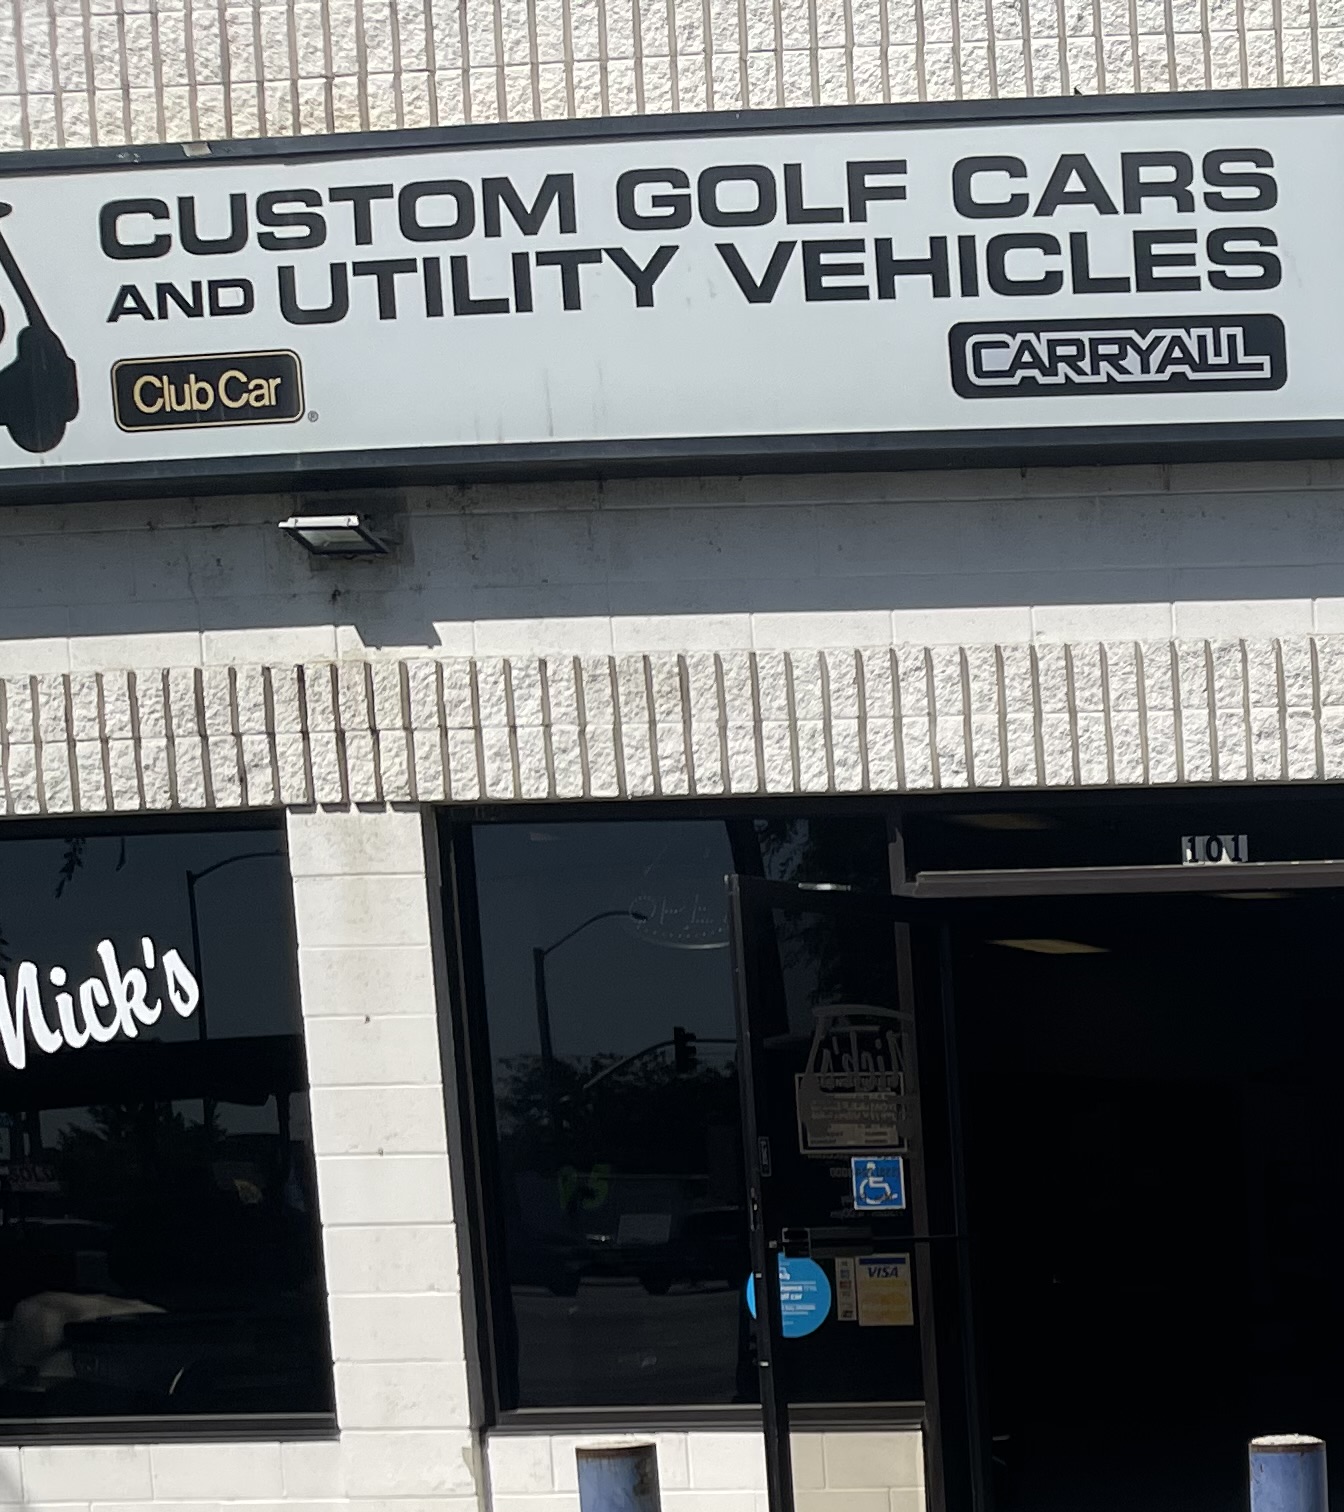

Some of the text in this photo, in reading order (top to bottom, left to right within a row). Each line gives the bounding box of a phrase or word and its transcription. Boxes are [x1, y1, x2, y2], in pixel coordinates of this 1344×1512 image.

[99, 148, 1278, 261] CUSTOM GOLF CARS
[106, 226, 1282, 326] AND UTILITY VEHICLES
[964, 326, 1272, 386] CARRYALL
[133, 368, 282, 416] Club Car
[1187, 834, 1243, 863] 101
[0, 936, 200, 1070] Nick's
[868, 1266, 899, 1278] VISA
